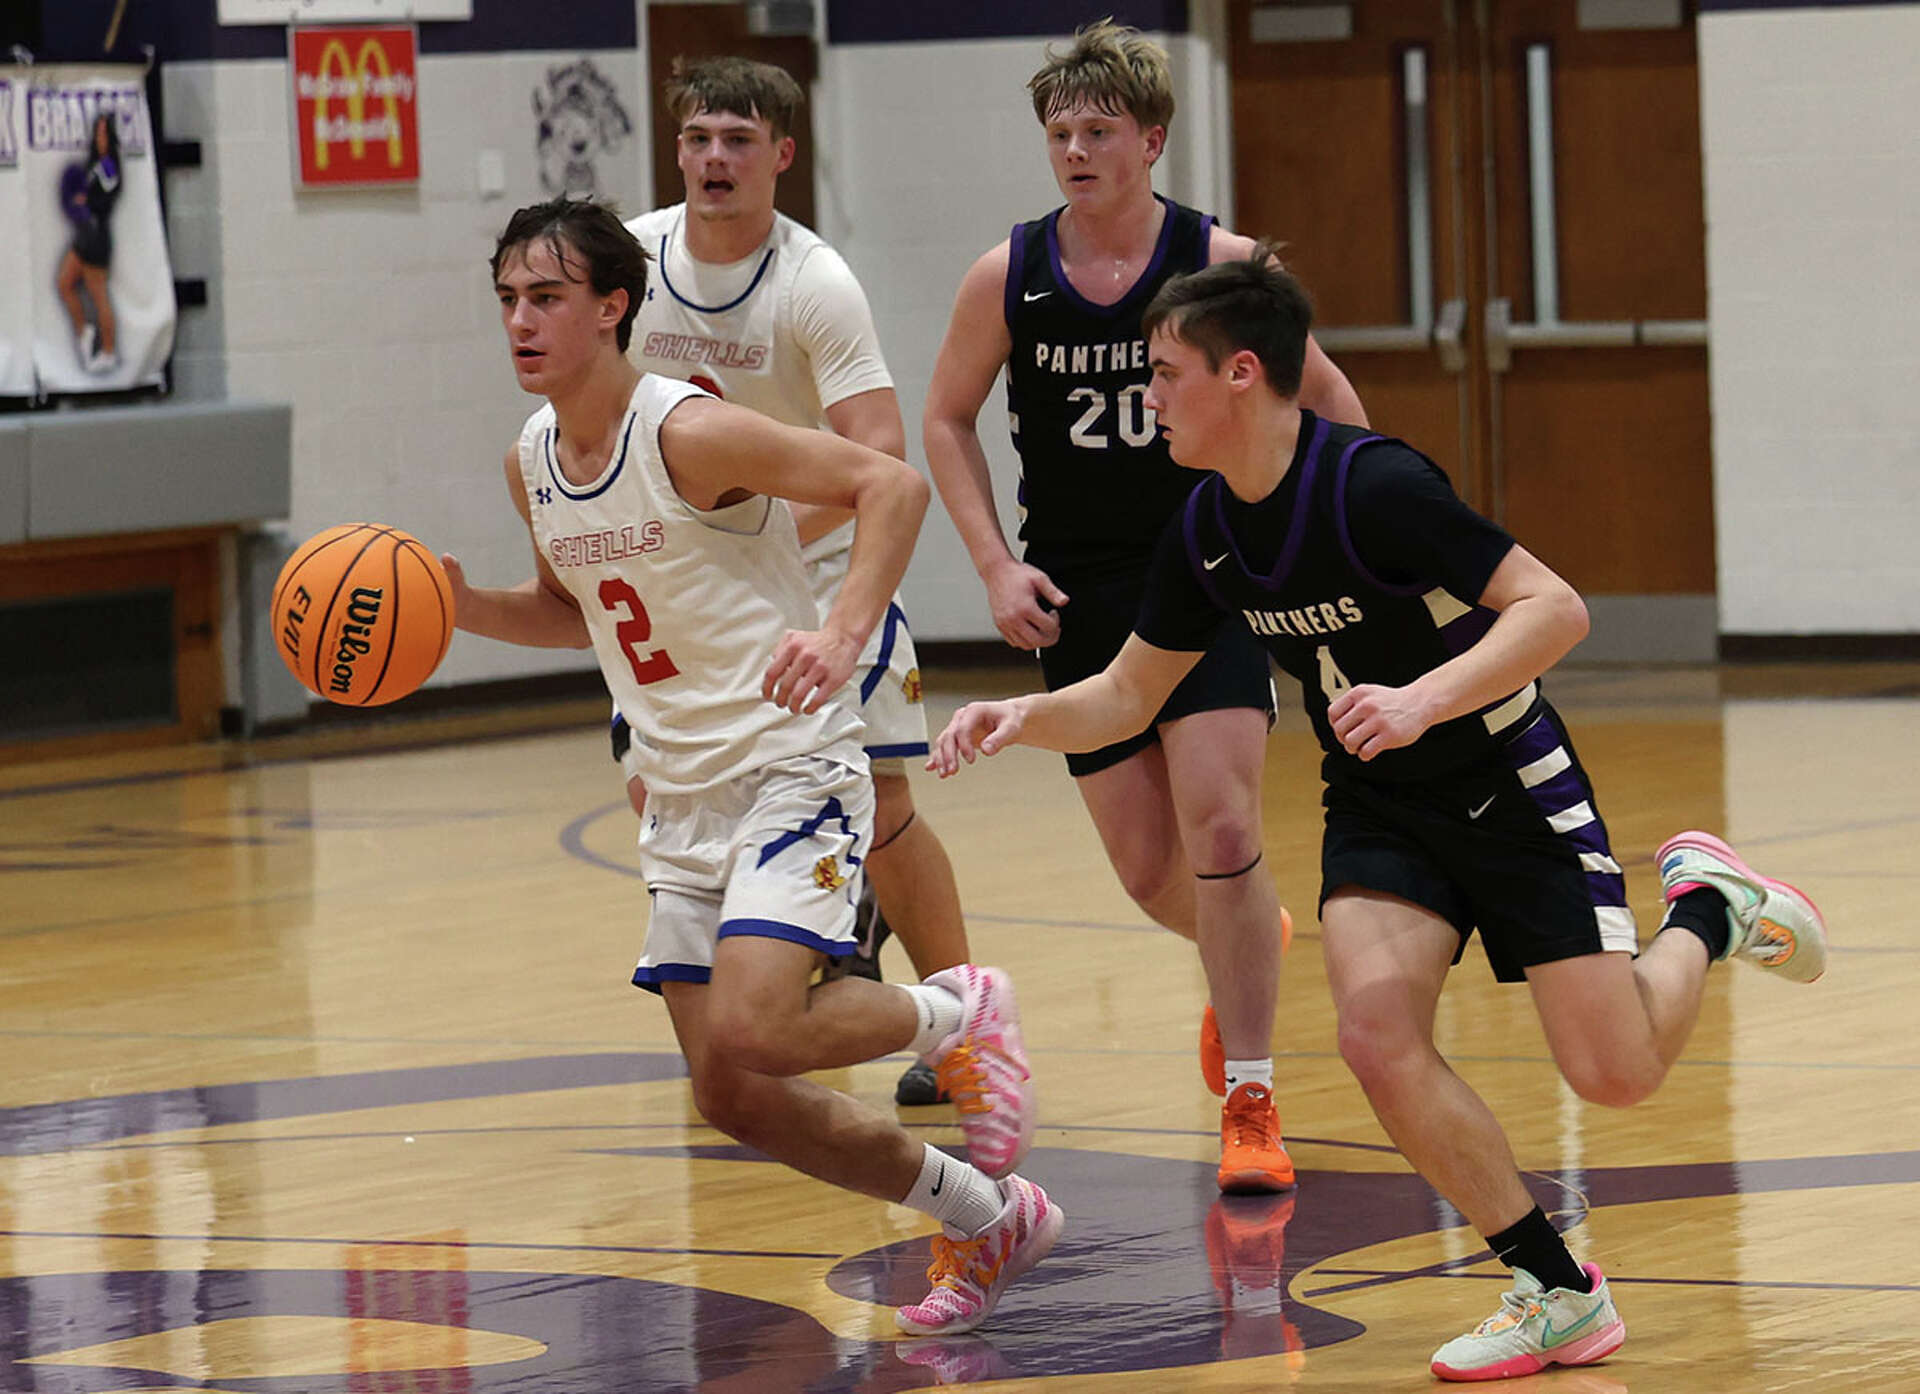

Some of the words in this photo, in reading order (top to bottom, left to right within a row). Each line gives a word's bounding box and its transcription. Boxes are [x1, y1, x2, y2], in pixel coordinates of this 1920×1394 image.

[643, 332, 768, 370] SHELLS
[1036, 340, 1145, 374] PANTHE
[1067, 384, 1157, 448] 20
[550, 520, 665, 567] SHELLS
[330, 587, 384, 694] Wilson
[598, 578, 681, 685] 2
[1317, 645, 1353, 703] 4
